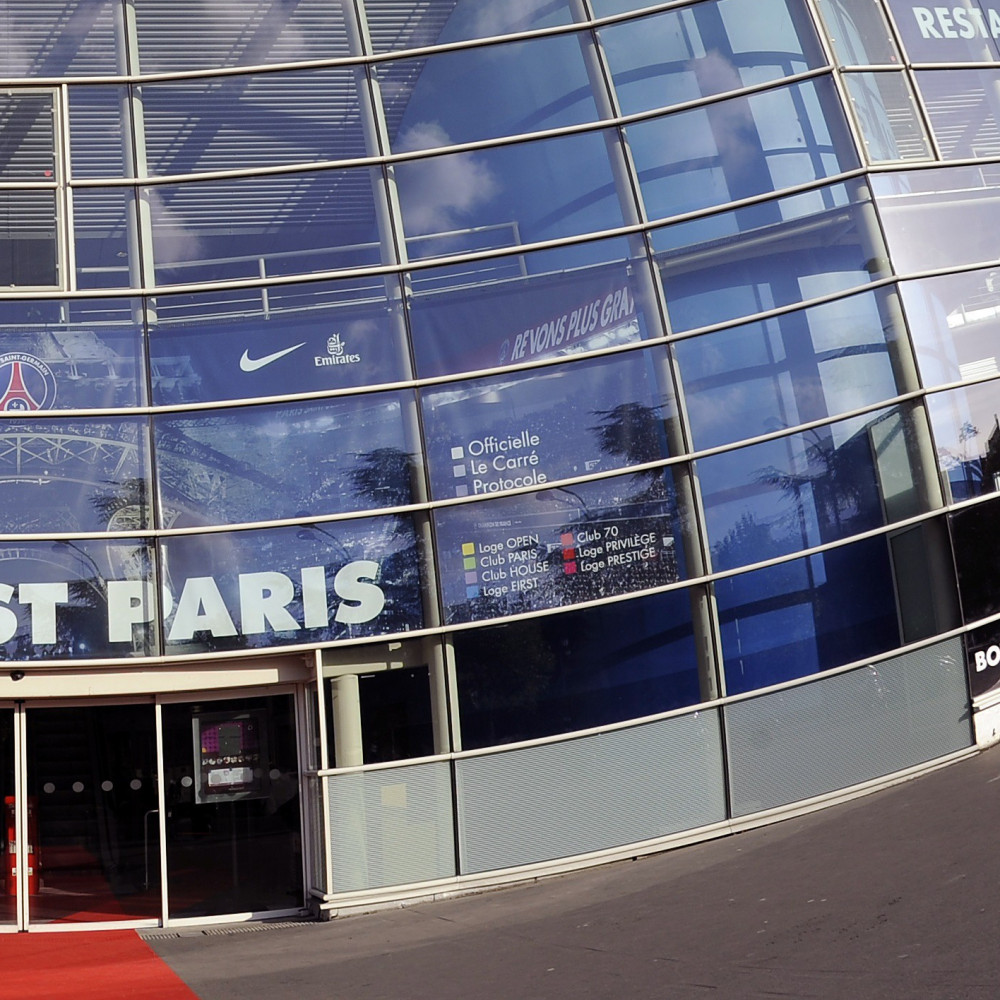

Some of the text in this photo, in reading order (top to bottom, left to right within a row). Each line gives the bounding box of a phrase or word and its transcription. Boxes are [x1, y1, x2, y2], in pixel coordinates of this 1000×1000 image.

[566, 300, 601, 340] PLUS
[314, 353, 360, 367] Emirates
[468, 429, 540, 456] Officielle
[471, 450, 539, 475] Le Carré
[473, 469, 547, 495] Protocole
[479, 534, 539, 554] Loge OPEN
[577, 525, 619, 543] Club 70
[578, 532, 656, 558] Loge PRIVILÈGE
[480, 549, 538, 567] Club PARIS
[580, 546, 656, 572] Loge PRESTIGE
[481, 561, 550, 582] Club HOUSE
[483, 577, 538, 597] Loge FIRST
[107, 560, 385, 643] PARIS
[974, 645, 1000, 672] BO
